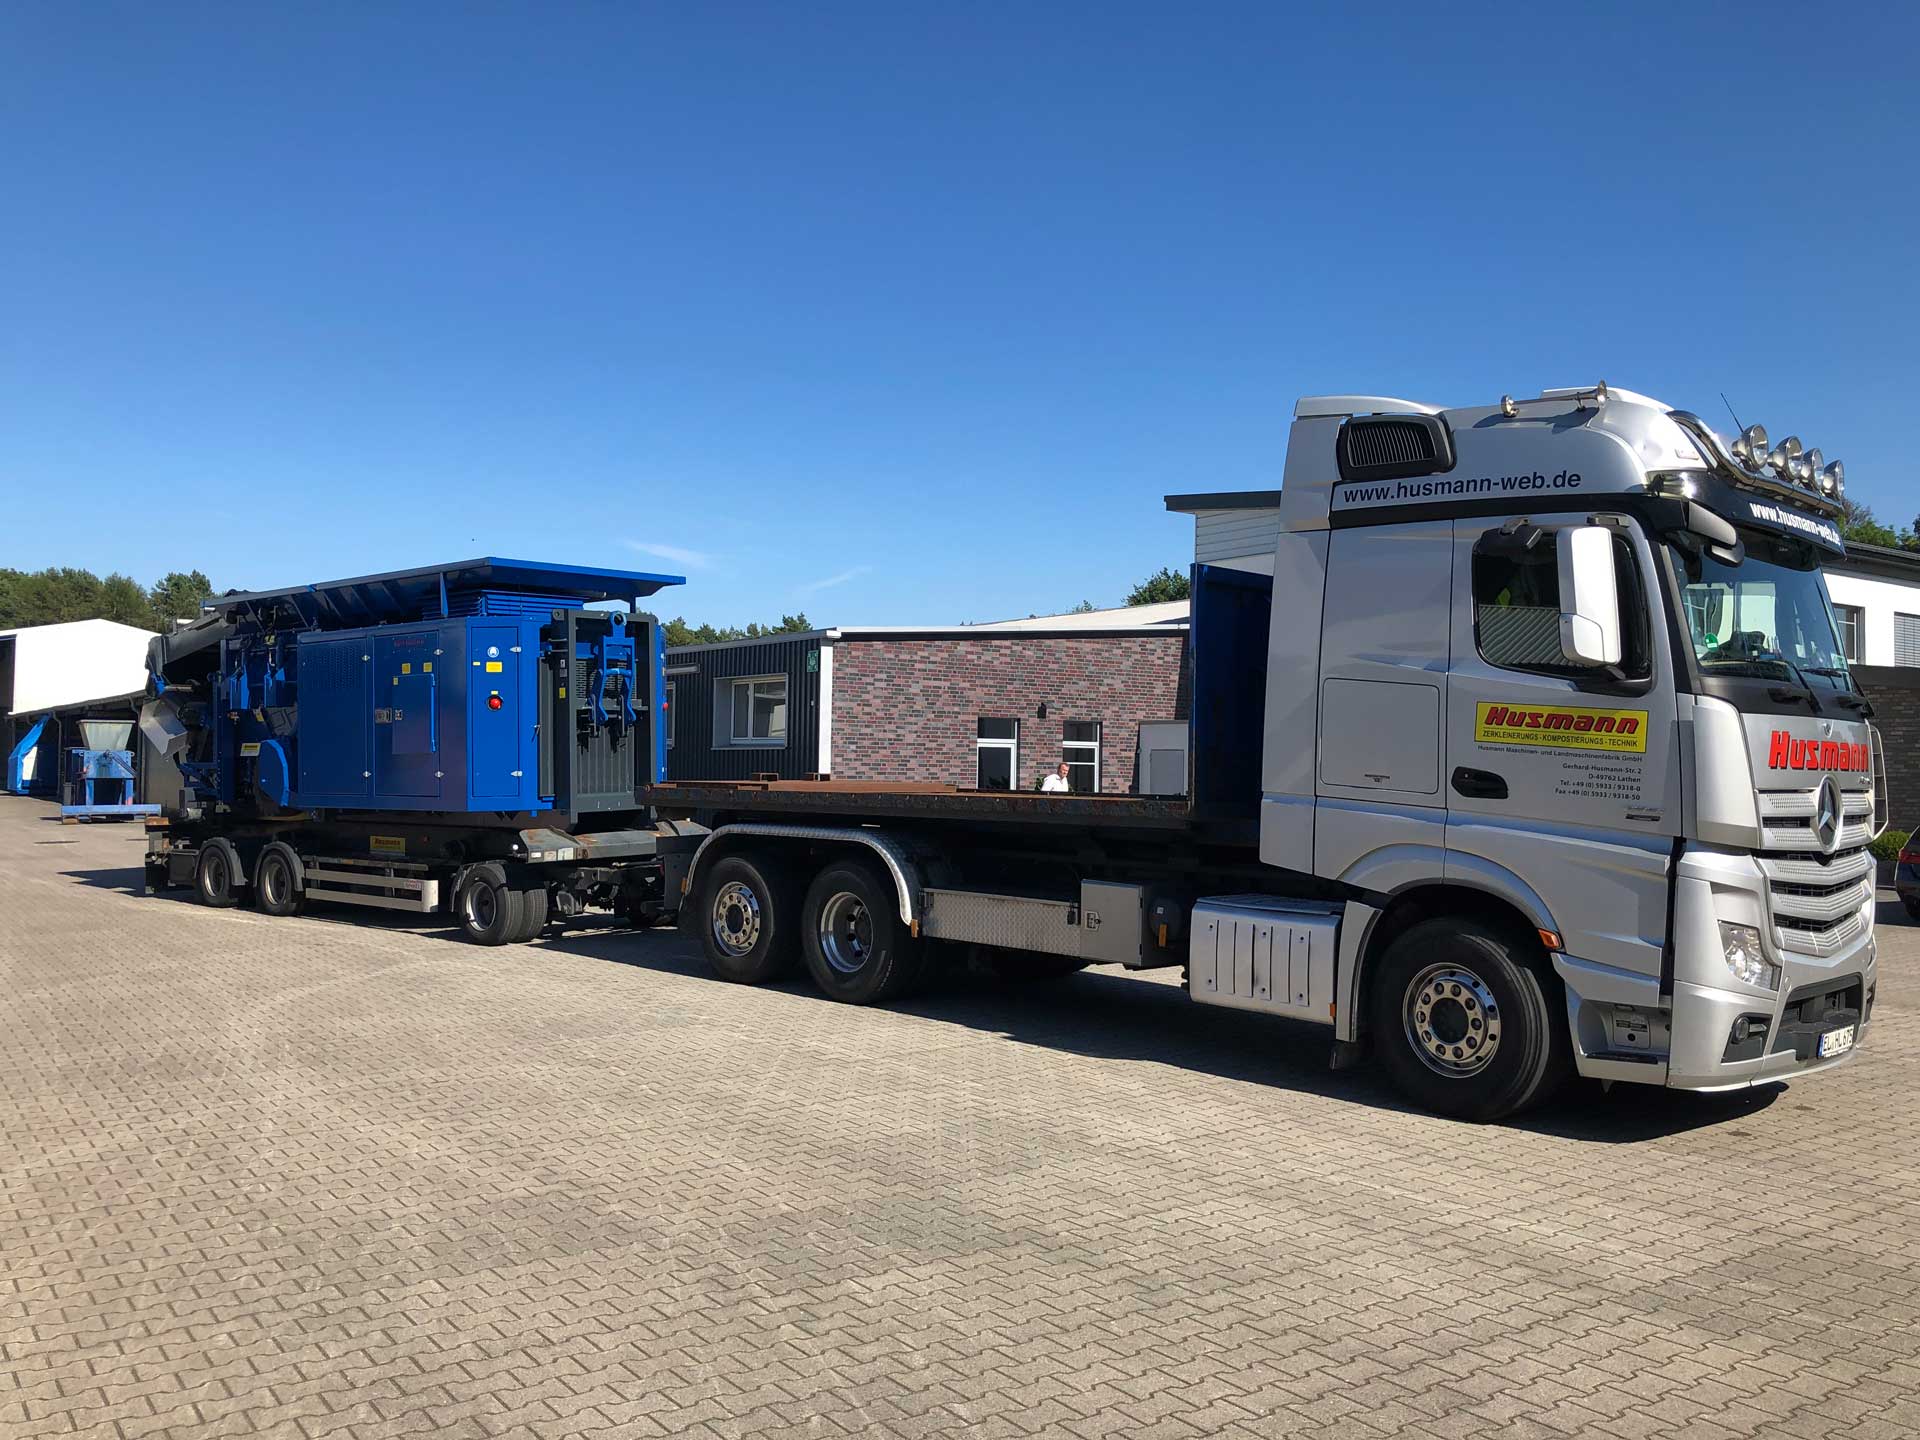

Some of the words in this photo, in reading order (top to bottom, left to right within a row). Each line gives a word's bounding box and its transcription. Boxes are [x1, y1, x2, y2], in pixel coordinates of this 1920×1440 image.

[1343, 470, 1582, 503] www.husmann-web.de
[1484, 706, 1640, 735] Husmann
[1478, 745, 1505, 753] Husmann
[1621, 754, 1643, 762] GmbH
[1769, 730, 1869, 773] Husmann
[1588, 773, 1616, 781] D-49762
[1617, 775, 1641, 783] Lathen
